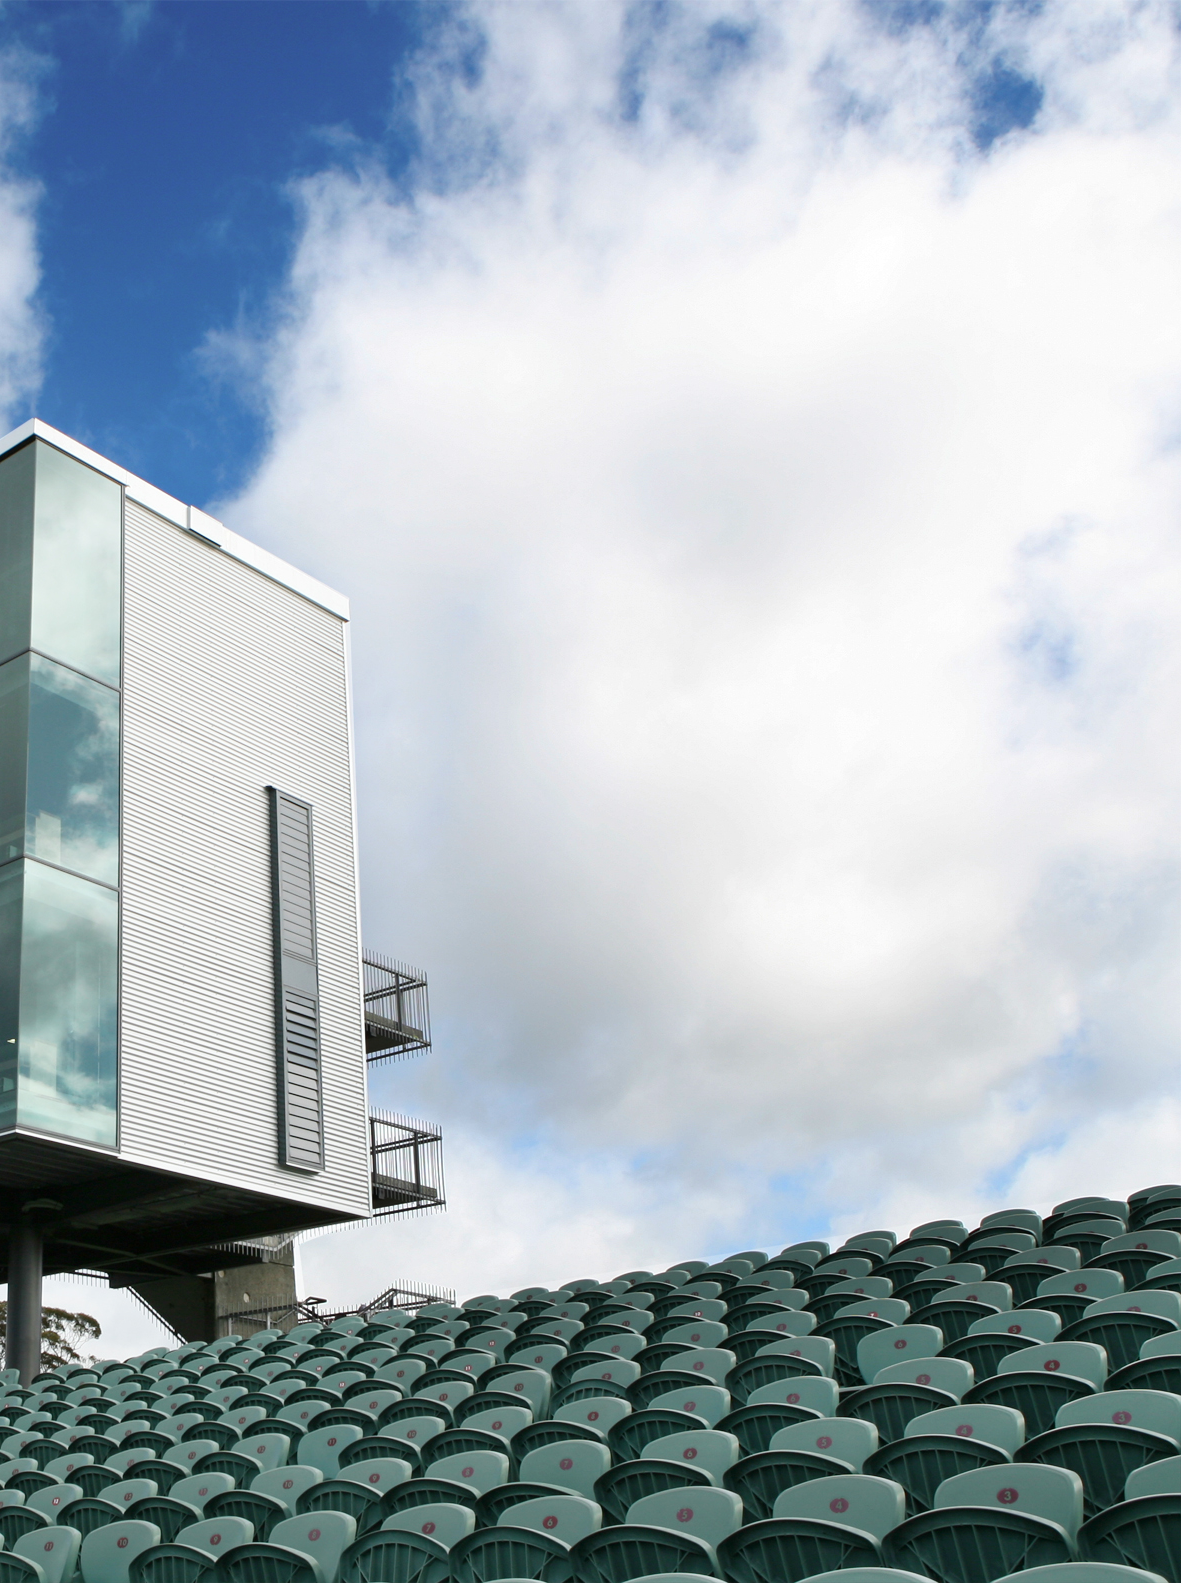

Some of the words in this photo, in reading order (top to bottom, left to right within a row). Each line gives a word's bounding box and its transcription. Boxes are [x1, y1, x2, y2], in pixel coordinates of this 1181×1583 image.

[1004, 1491, 1011, 1501] 3
[835, 1501, 843, 1510] 4
[682, 1511, 688, 1519] 5
